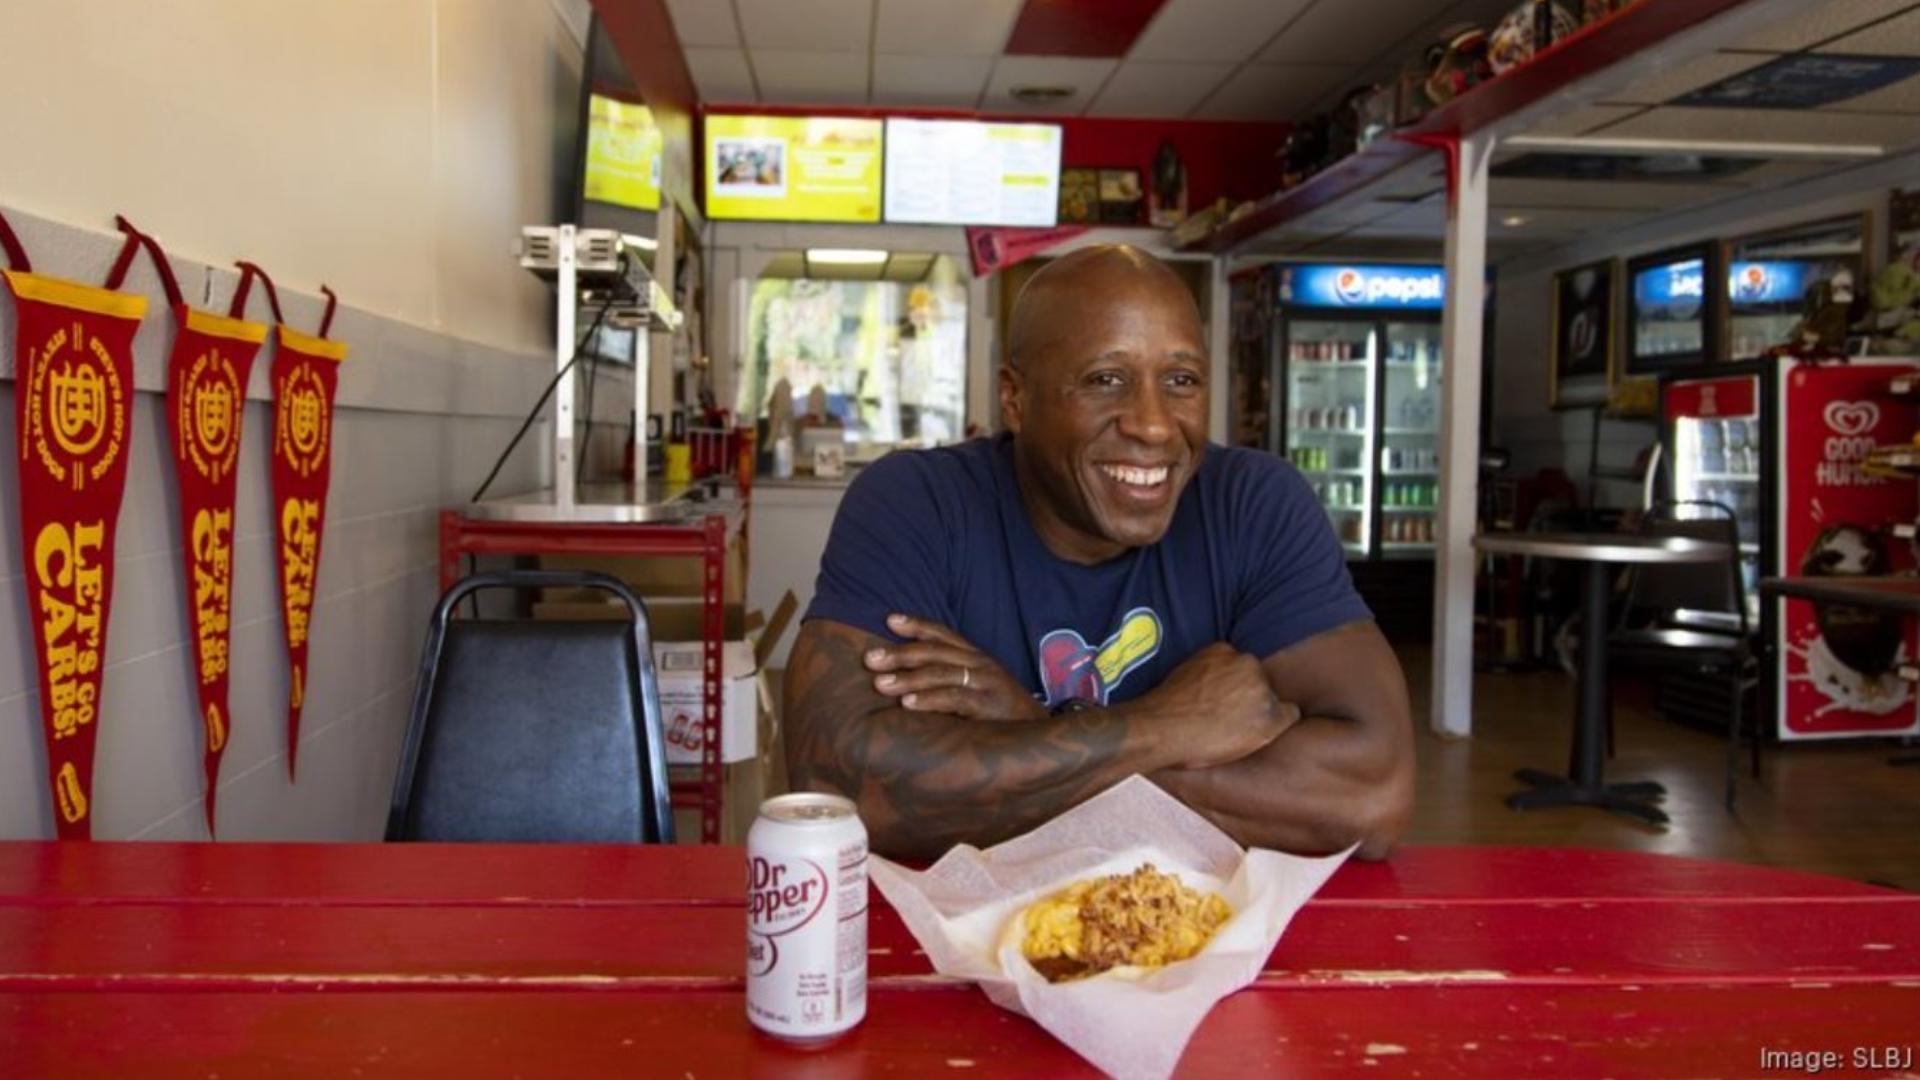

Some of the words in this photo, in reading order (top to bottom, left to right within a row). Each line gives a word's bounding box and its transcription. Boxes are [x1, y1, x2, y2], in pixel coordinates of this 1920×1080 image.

[74, 518, 105, 675] LET'S
[33, 521, 77, 741] CARBS!
[76, 681, 96, 724] GO
[753, 857, 787, 889] Dr
[747, 877, 817, 924] epper
